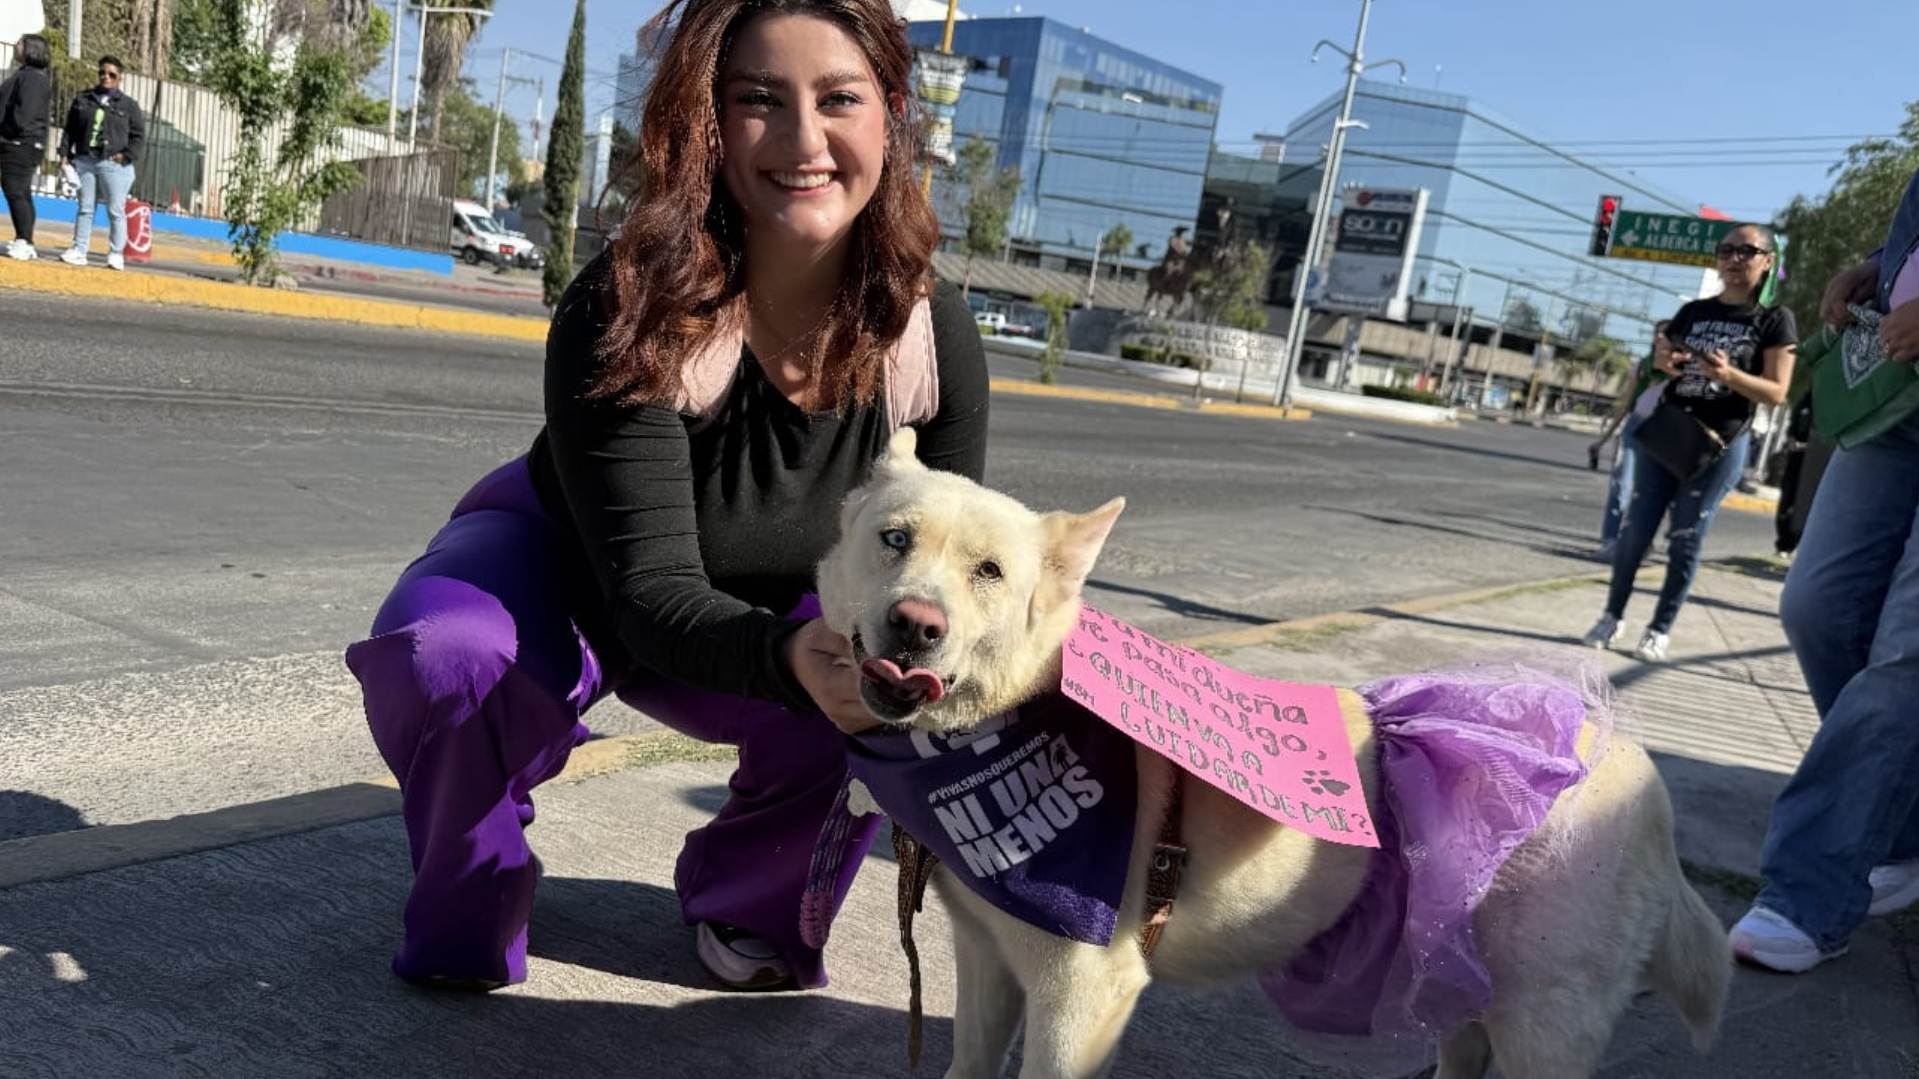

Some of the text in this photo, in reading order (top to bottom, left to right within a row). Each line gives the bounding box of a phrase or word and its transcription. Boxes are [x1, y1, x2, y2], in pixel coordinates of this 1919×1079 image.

[1634, 215, 1714, 237] INEGI
[928, 731, 1050, 804] #VIVASNOSQUEREMOS
[933, 793, 994, 844] NI
[956, 765, 1104, 878] MENOS
